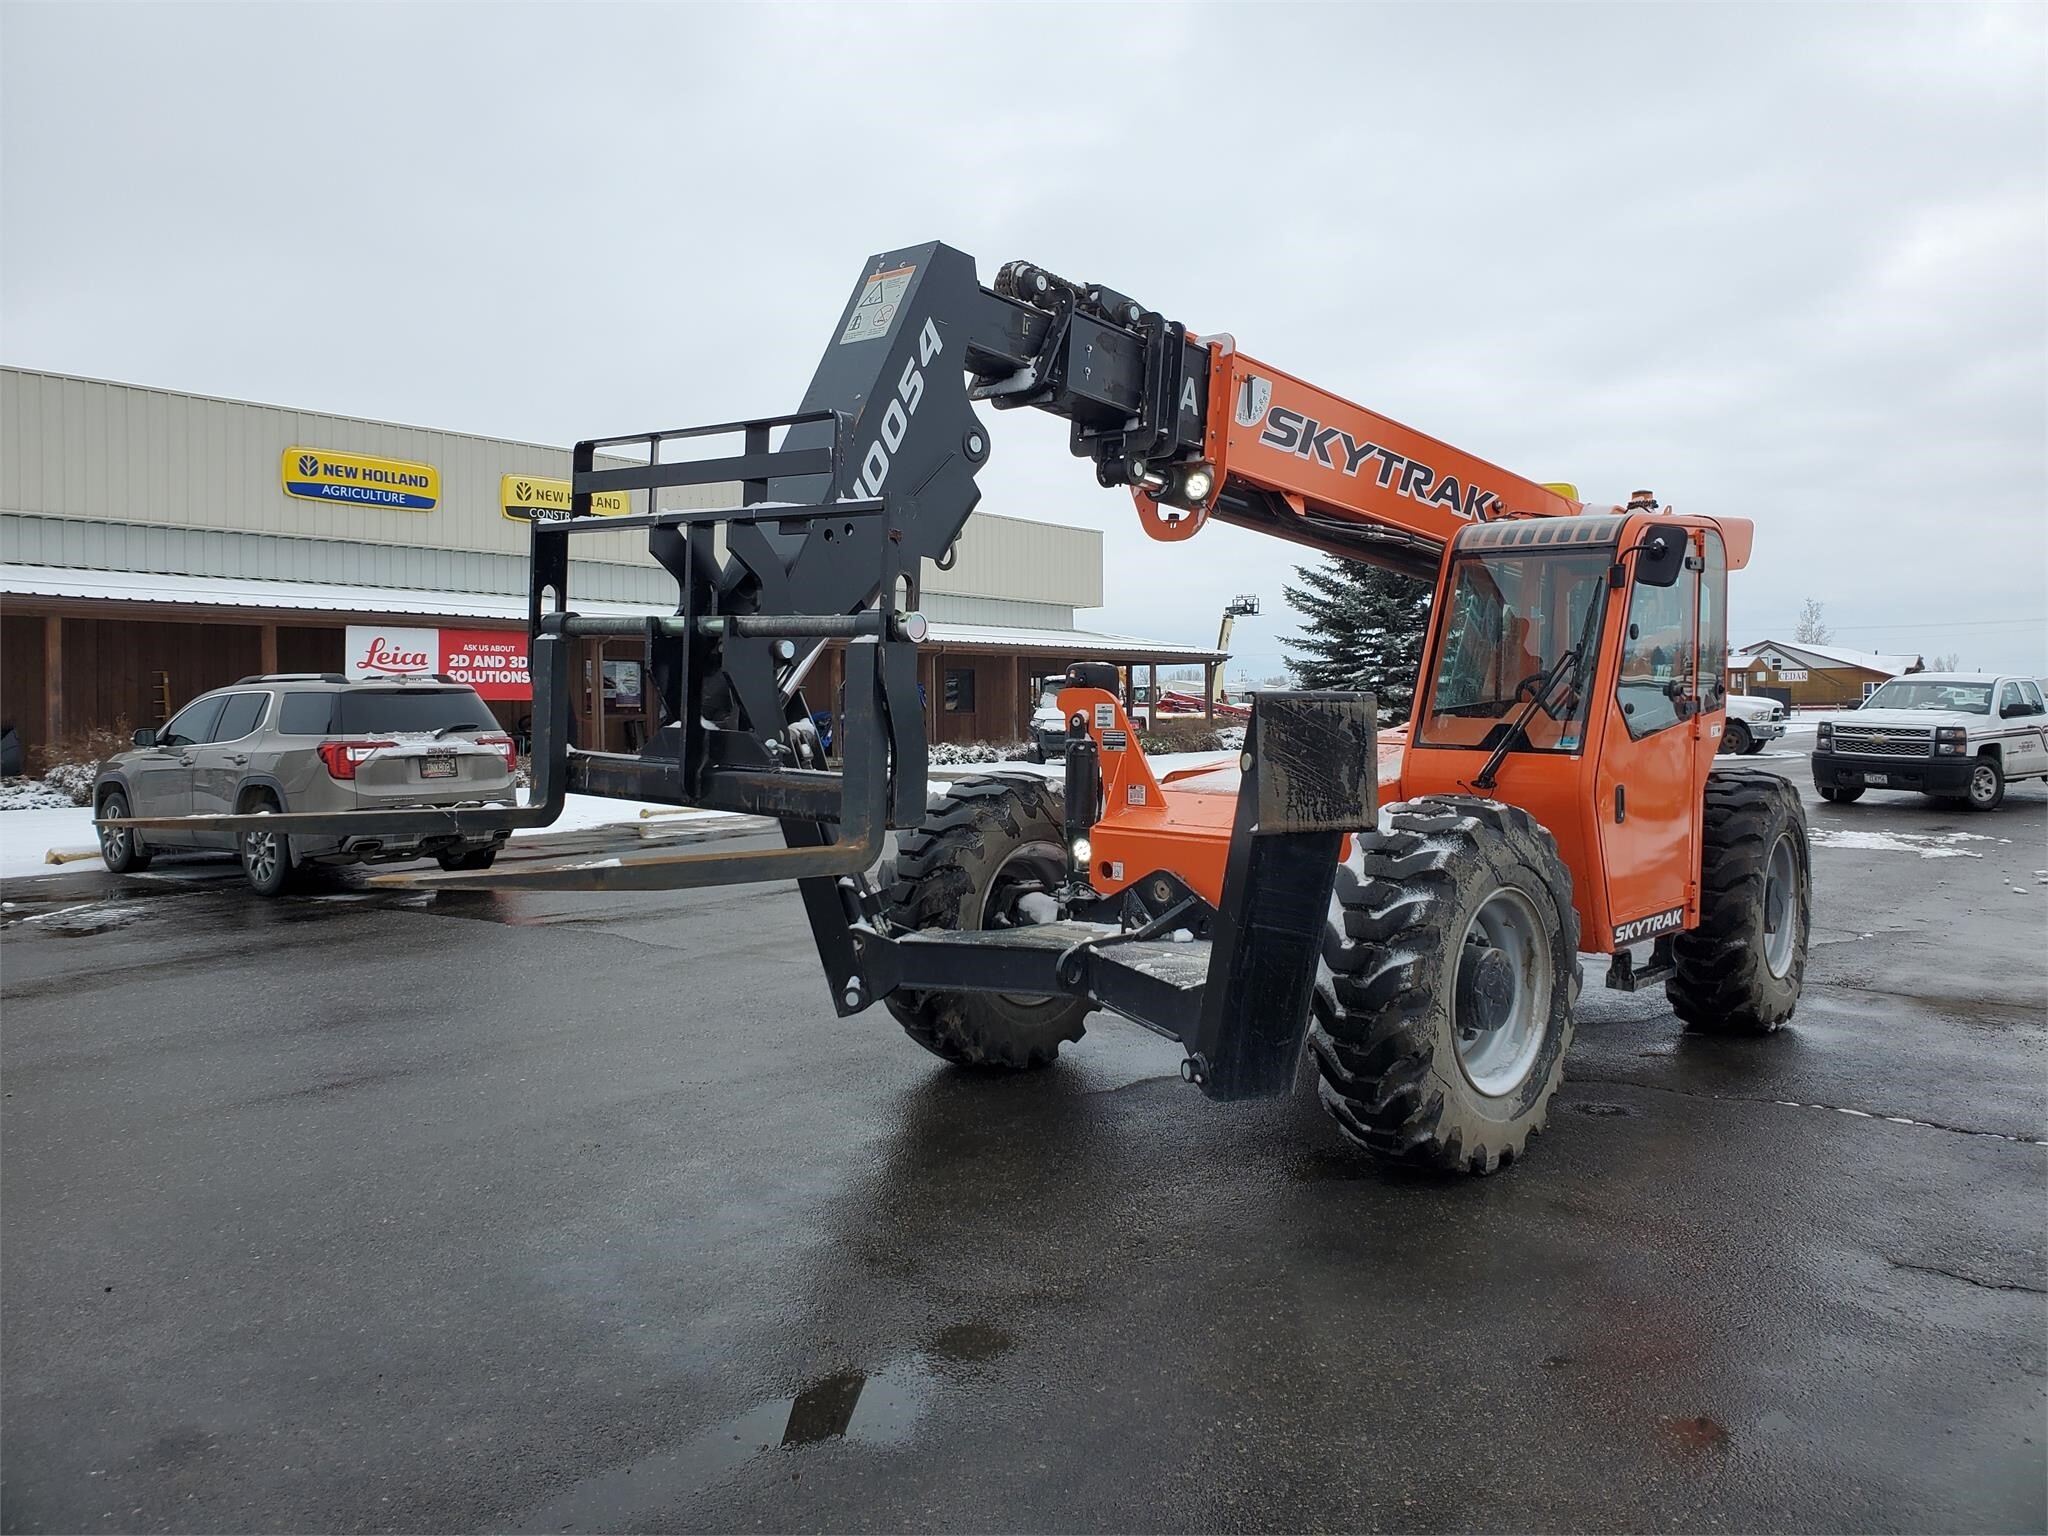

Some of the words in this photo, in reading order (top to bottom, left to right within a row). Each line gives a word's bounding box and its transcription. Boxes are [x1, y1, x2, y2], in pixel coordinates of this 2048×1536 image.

[1180, 376, 1198, 416] A
[852, 316, 943, 500] 10054
[323, 463, 358, 480] NEW
[362, 468, 429, 488] HOLLAND
[1259, 406, 1499, 523] SKYTRAK
[321, 484, 406, 504] AGRICULTURE
[536, 489, 564, 502] NEW
[356, 637, 429, 673] Leica
[463, 644, 478, 652] ASK
[490, 645, 515, 653] ABOUT
[449, 654, 470, 667] 2D
[473, 655, 506, 668] AND
[509, 656, 528, 668] 3D
[447, 670, 531, 684] SOLUTIONS
[1779, 671, 1807, 680] CEDAR
[1614, 908, 1683, 943] SKYTRAK
